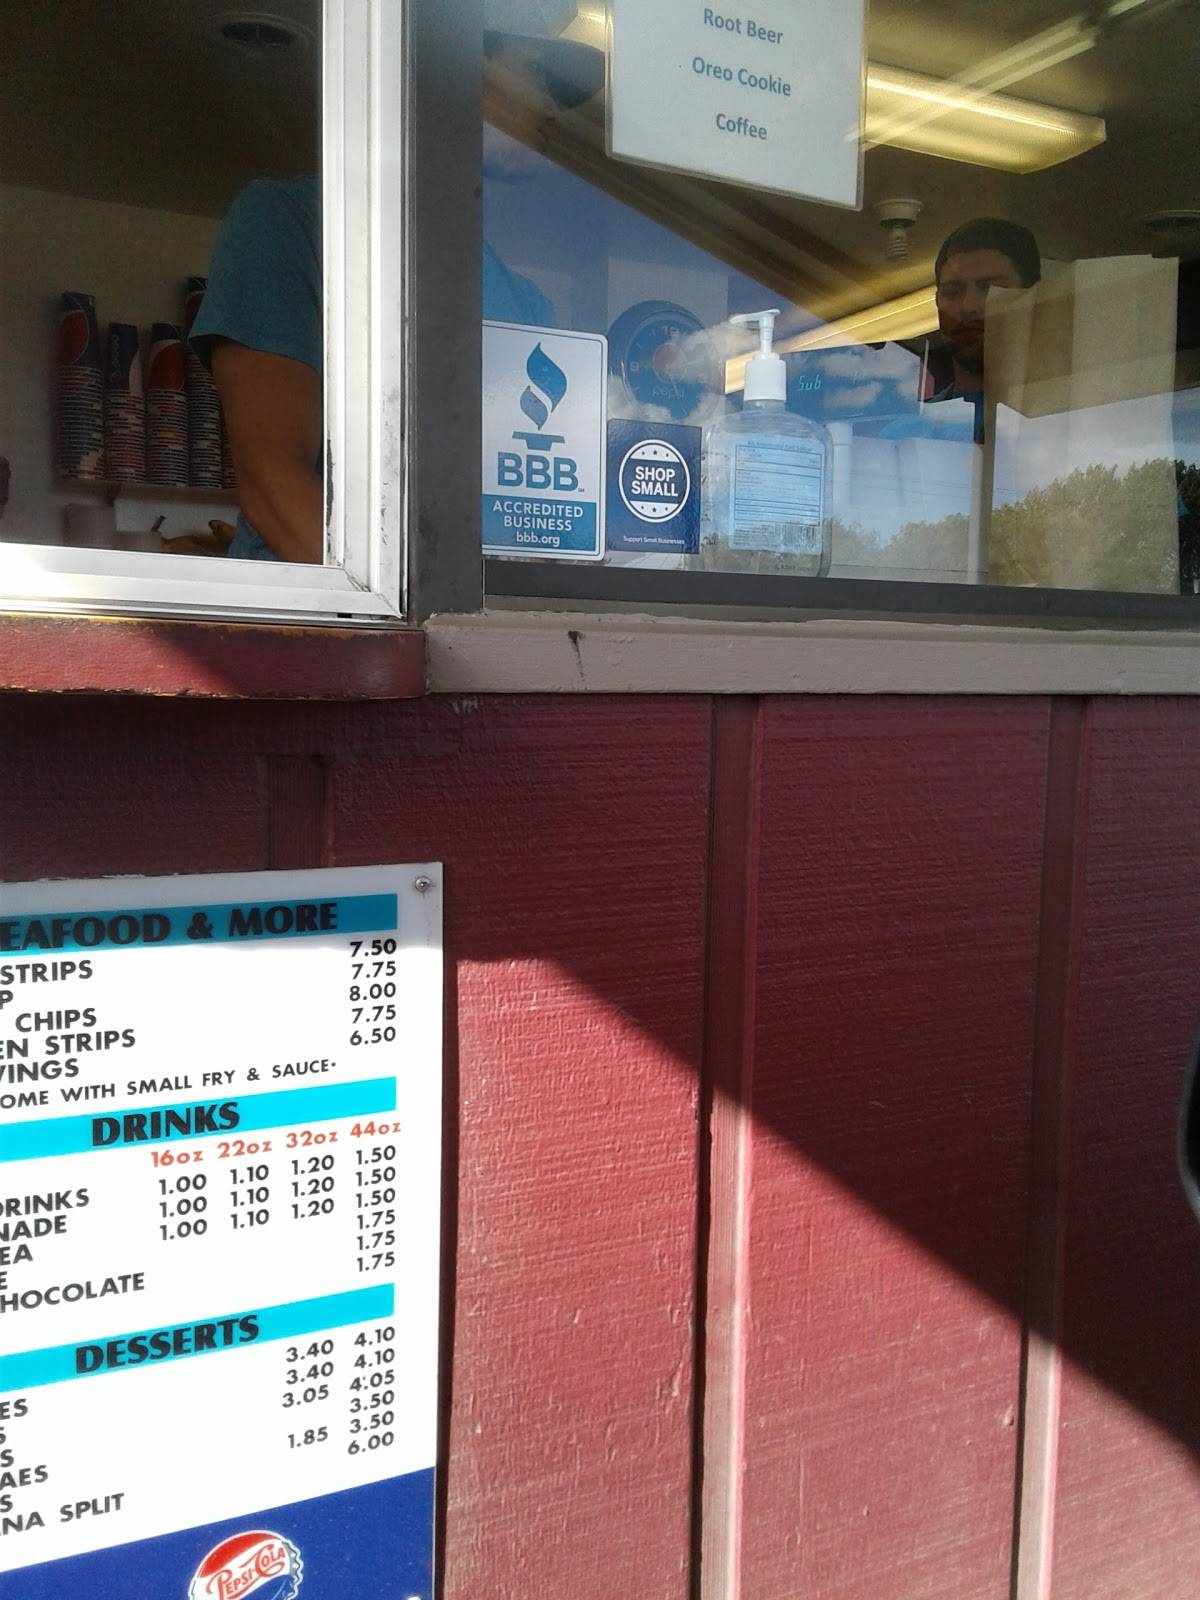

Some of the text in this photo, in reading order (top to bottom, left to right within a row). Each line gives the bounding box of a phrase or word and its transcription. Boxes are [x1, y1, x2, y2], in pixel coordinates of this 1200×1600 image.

[704, 8, 783, 44] Root Beer
[692, 56, 791, 96] Oreo Cookie
[716, 113, 768, 140] Coffee
[498, 452, 579, 492] BBB
[631, 481, 678, 497] SMALL
[635, 466, 675, 481] SHOP
[493, 501, 583, 517] ACCREDITED
[504, 516, 572, 531] BUSINESS
[516, 531, 560, 547] bbb.org
[187, 913, 214, 940] &
[229, 902, 338, 937] MORE
[0, 939, 397, 986] STRIPS 7.50
[351, 960, 397, 980] 7.75
[15, 981, 397, 1033] CHIPS 8.00
[45, 1028, 136, 1056] STRIPS
[351, 1004, 396, 1024] 7.75
[0, 1026, 396, 1085] INGS 6.50
[0, 1090, 49, 1109] OME
[60, 1083, 115, 1102] WITH
[127, 1075, 193, 1096] SMALL
[202, 1070, 236, 1087] FRY
[246, 1067, 260, 1082] &
[91, 1102, 241, 1147] DRINKS
[150, 1119, 402, 1168] 16oz 22oz 32oz 44oz
[0, 1144, 396, 1218] RINKS 1.00 1.10 1.20 1.50
[159, 1196, 208, 1218] 1.00
[230, 1186, 270, 1207] 1.10
[291, 1176, 335, 1197] 1.20
[355, 1166, 396, 1187] 1.50
[159, 1218, 208, 1241] 1.00
[230, 1208, 270, 1229] 1.10
[291, 1198, 335, 1219] 1.20
[355, 1187, 396, 1209] 1.50
[357, 1209, 396, 1230] 1.75
[0, 1229, 396, 1314] HOCOLATE 1.75
[356, 1251, 395, 1272] 1.75
[75, 1315, 259, 1376] DESSERTS
[286, 1339, 334, 1363] 3.40
[354, 1326, 395, 1347] 4.10
[286, 1348, 395, 1385] 3.40 4.10
[282, 1384, 329, 1408] 3.05
[349, 1370, 396, 1392] 4.05
[349, 1389, 395, 1413] 3.50
[287, 1426, 328, 1449] 1.85
[349, 1410, 394, 1434] 3.50
[60, 1492, 124, 1522] SPLIT
[347, 1431, 394, 1455] 6.00
